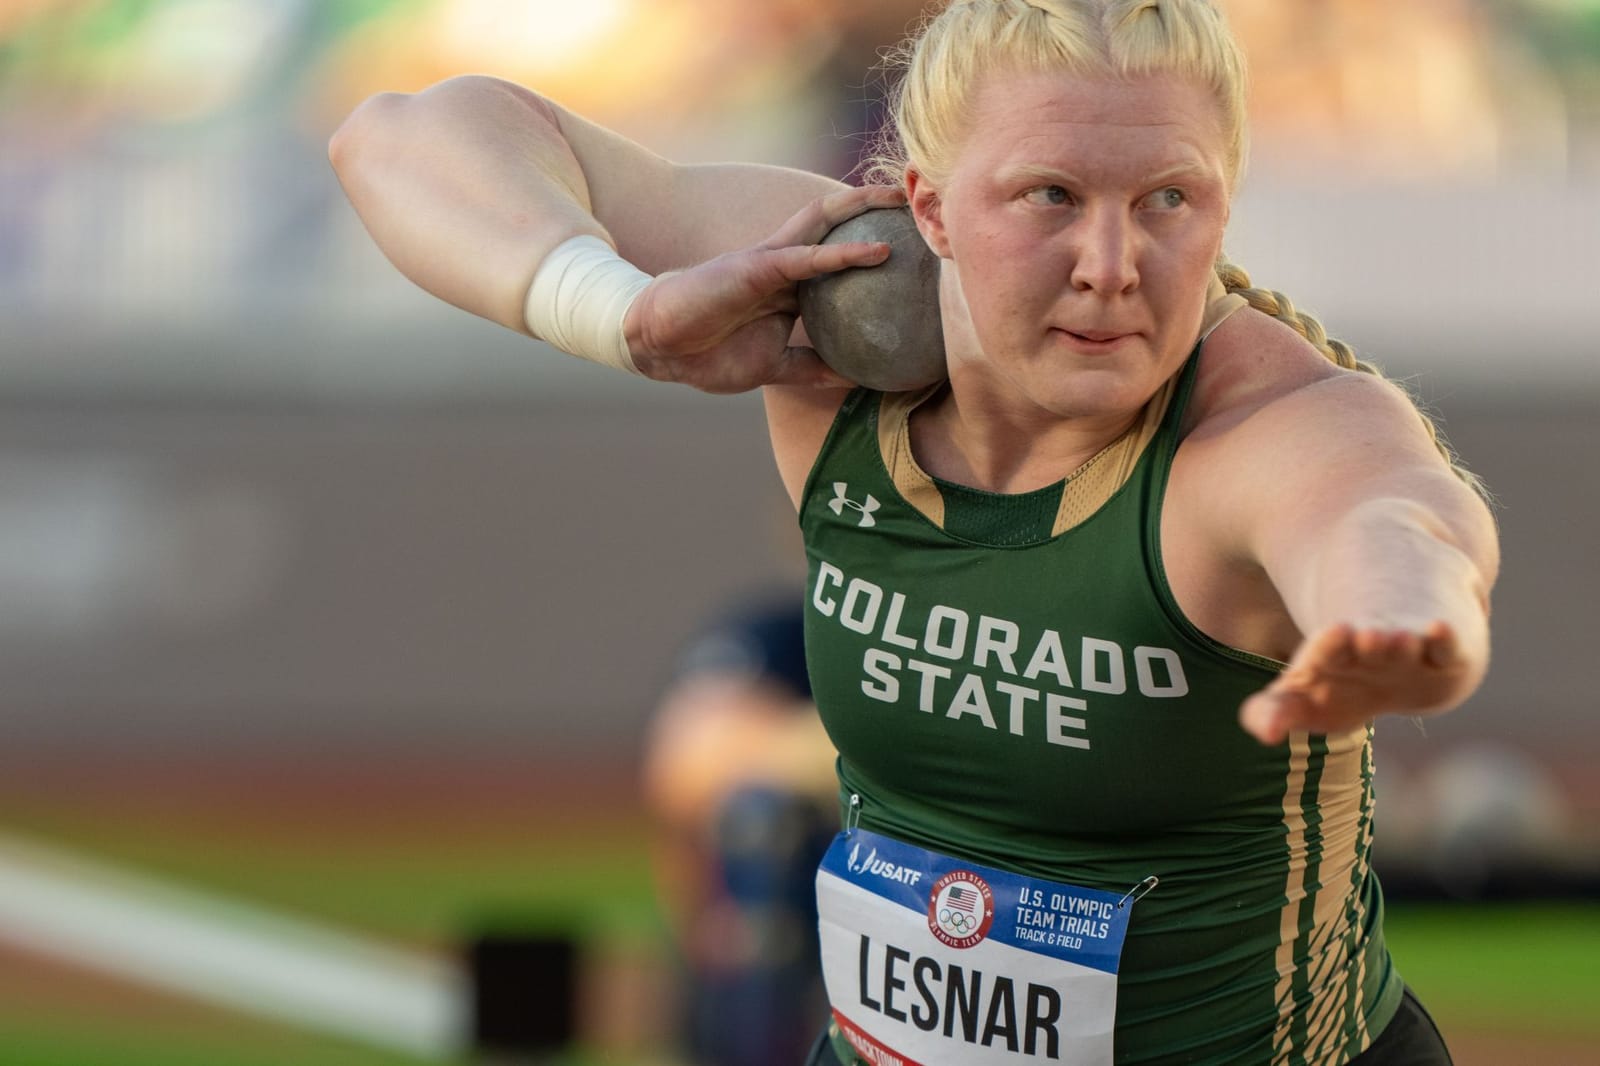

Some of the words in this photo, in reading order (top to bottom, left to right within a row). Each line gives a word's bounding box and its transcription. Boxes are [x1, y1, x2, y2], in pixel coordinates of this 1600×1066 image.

[813, 561, 1189, 698] COLORADO
[861, 648, 1091, 750] STATE
[870, 859, 922, 886] USATF
[939, 872, 967, 888] UNITED
[969, 873, 991, 899] STATES
[1019, 887, 1045, 908] U.S.
[1050, 893, 1113, 920] OLYMPIC
[1015, 926, 1047, 944] TRACK
[1047, 932, 1056, 945] &
[1056, 934, 1083, 950] FIELD
[1016, 906, 1056, 930] TEAM
[1060, 915, 1109, 939] TRIALS
[962, 933, 982, 947] TEAM
[860, 934, 1062, 1061] LESNAR
